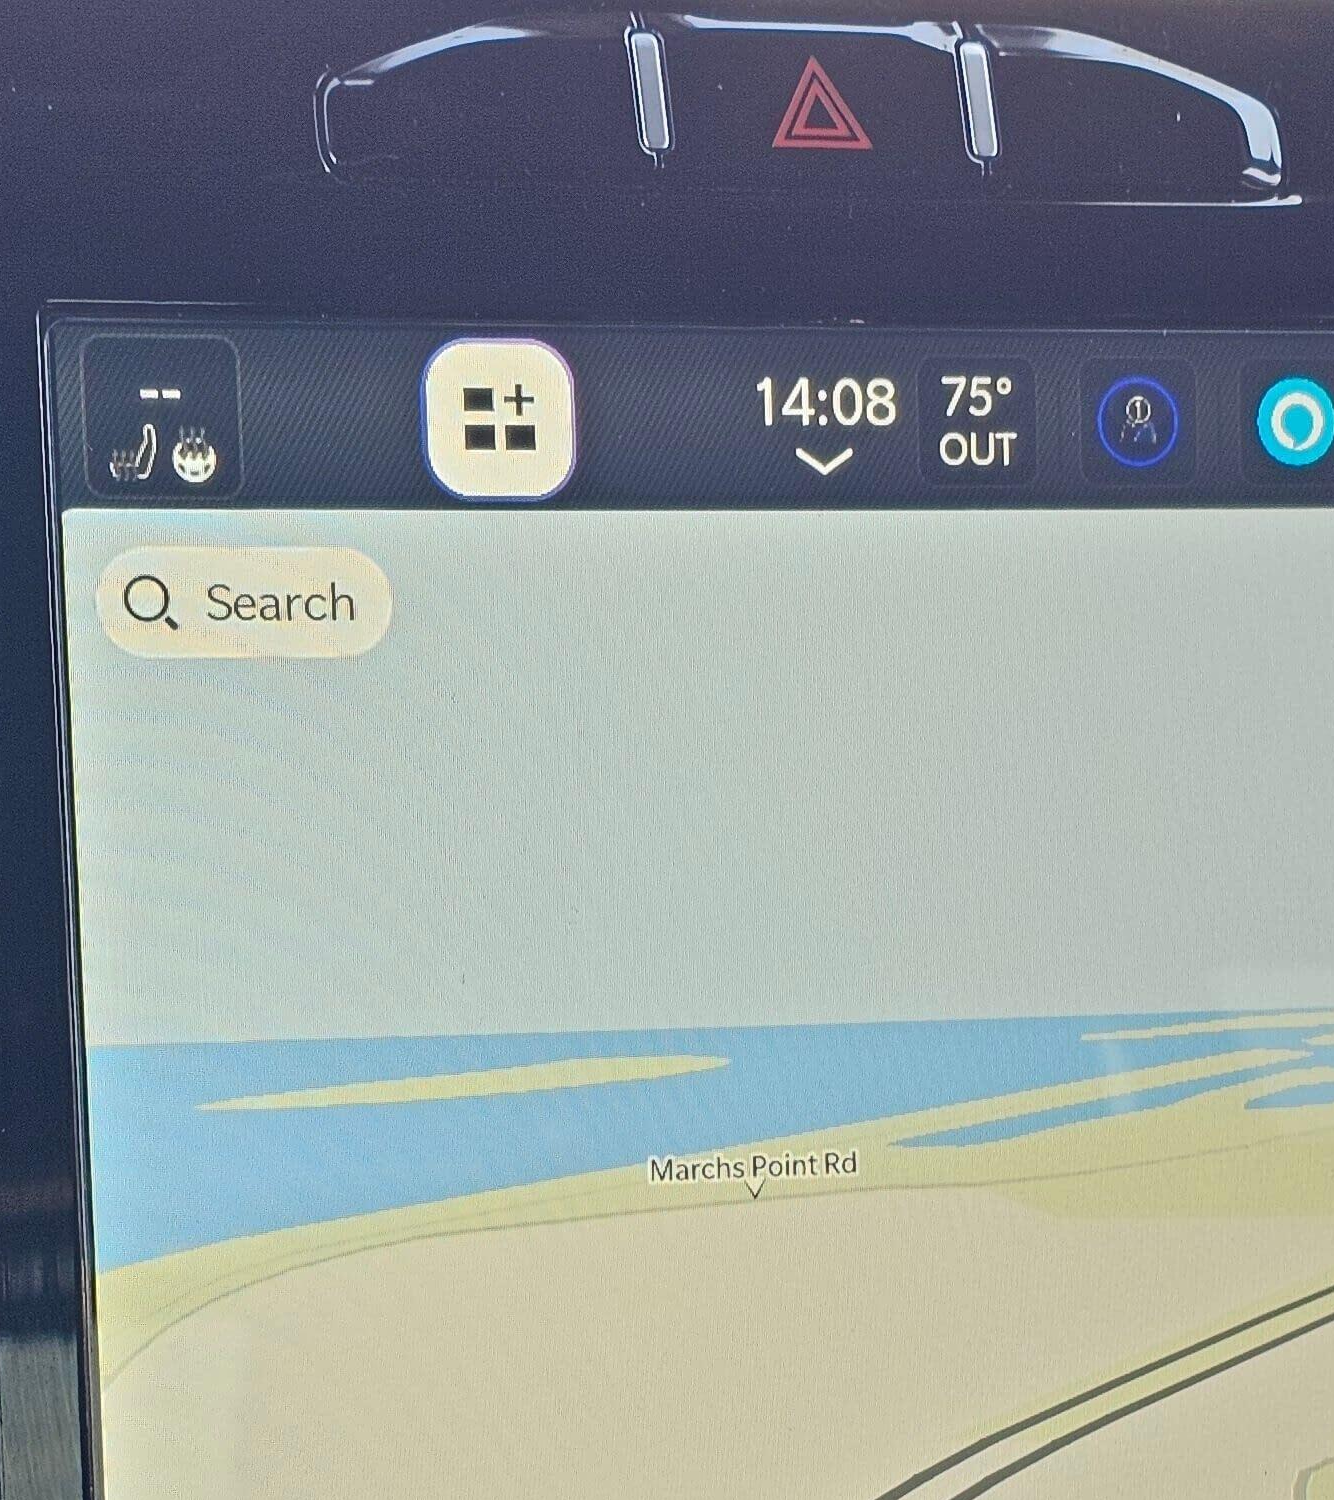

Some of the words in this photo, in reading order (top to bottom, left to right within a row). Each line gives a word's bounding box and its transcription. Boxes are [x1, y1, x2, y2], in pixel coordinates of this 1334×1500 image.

[756, 376, 897, 427] 14:08
[940, 375, 1012, 417] 75°
[939, 431, 1018, 467] OUT
[206, 581, 355, 622] Search
[651, 1156, 745, 1182] Marchs
[752, 1153, 818, 1178] Point
[824, 1151, 857, 1175] Rd
